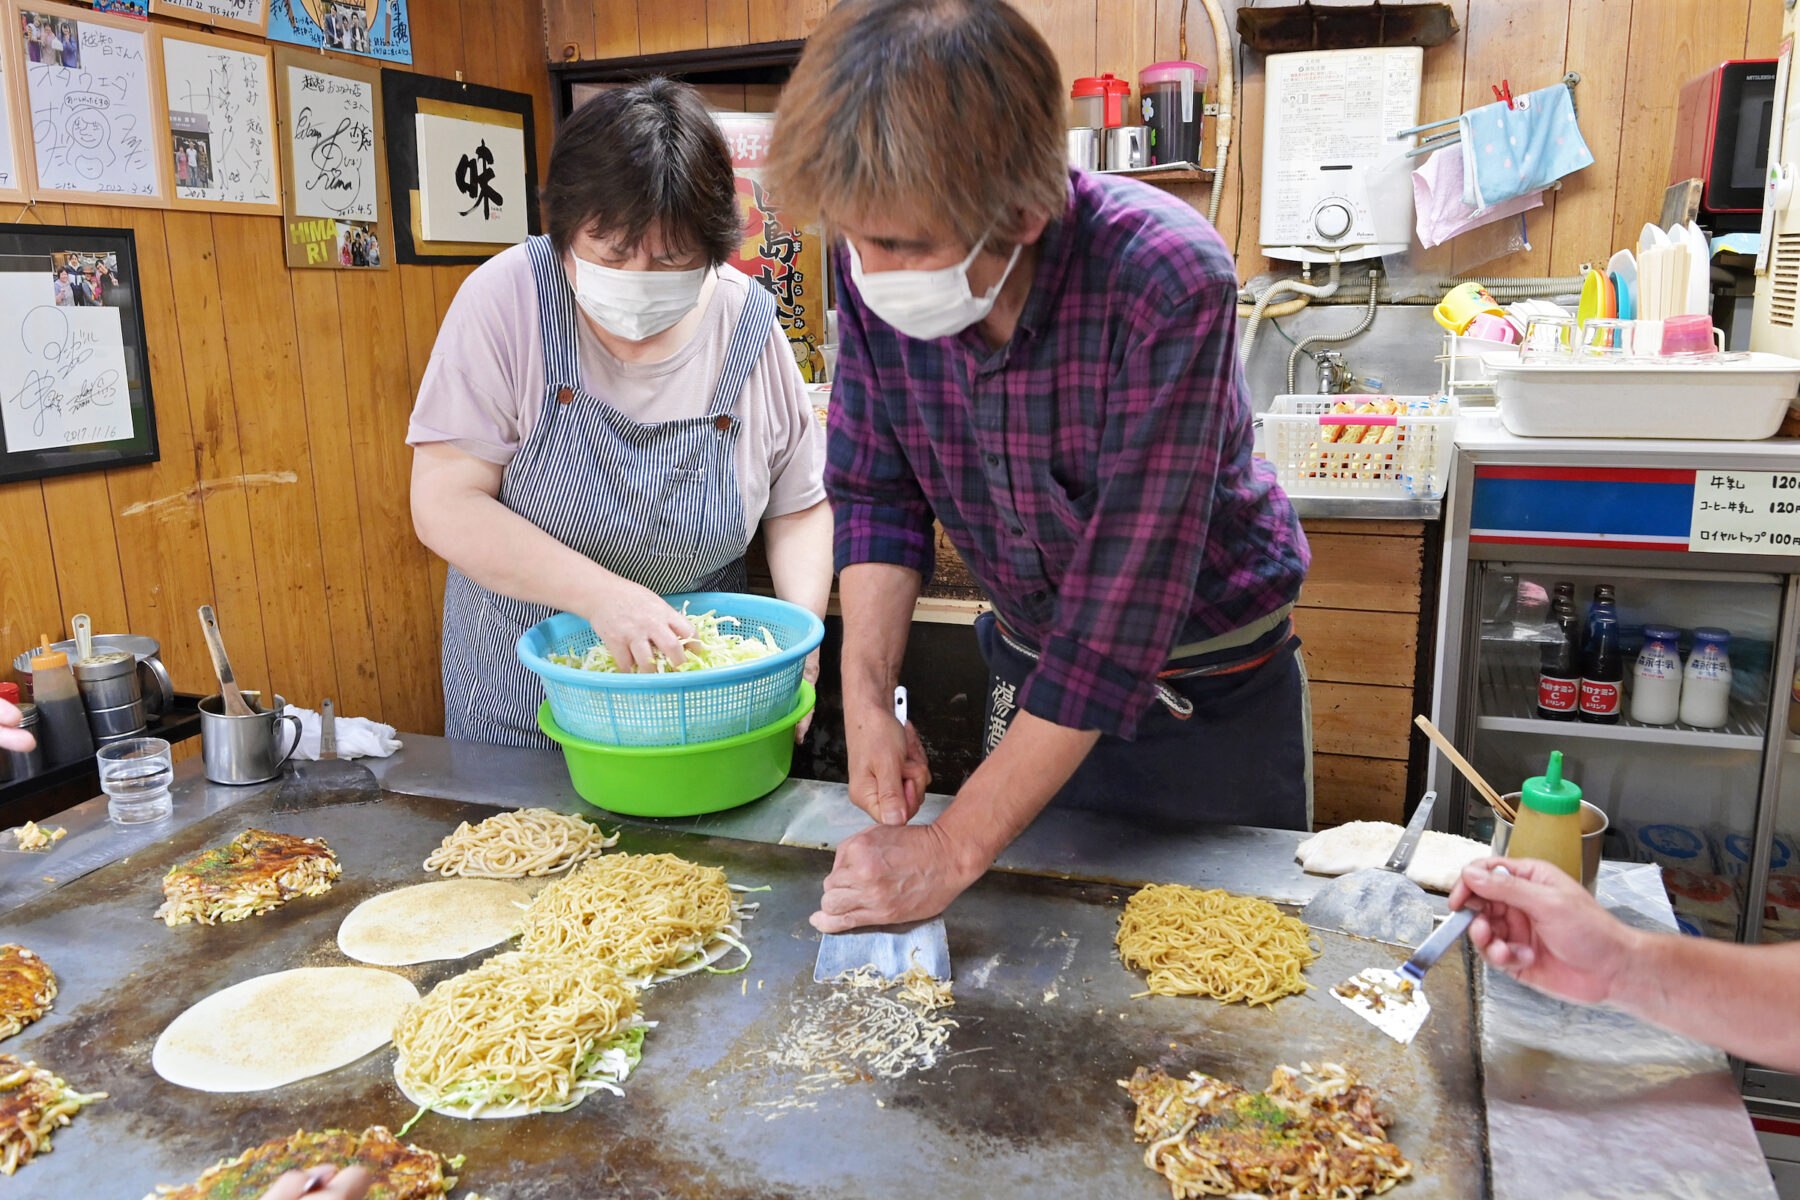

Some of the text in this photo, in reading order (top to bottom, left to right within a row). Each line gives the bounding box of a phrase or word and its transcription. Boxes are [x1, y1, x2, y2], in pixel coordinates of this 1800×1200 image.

[454, 138, 504, 221] 味
[290, 218, 340, 245] HIMA
[306, 241, 329, 265] RI
[1710, 474, 1746, 490] 牛乳
[1699, 501, 1755, 514] コーヒー牛乳
[1700, 530, 1768, 543] ロイヤルトップ
[1638, 655, 1675, 670] 森永牛乳
[1691, 659, 1728, 672] 森永牛乳
[1551, 692, 1560, 700] C
[1591, 695, 1601, 703] C
